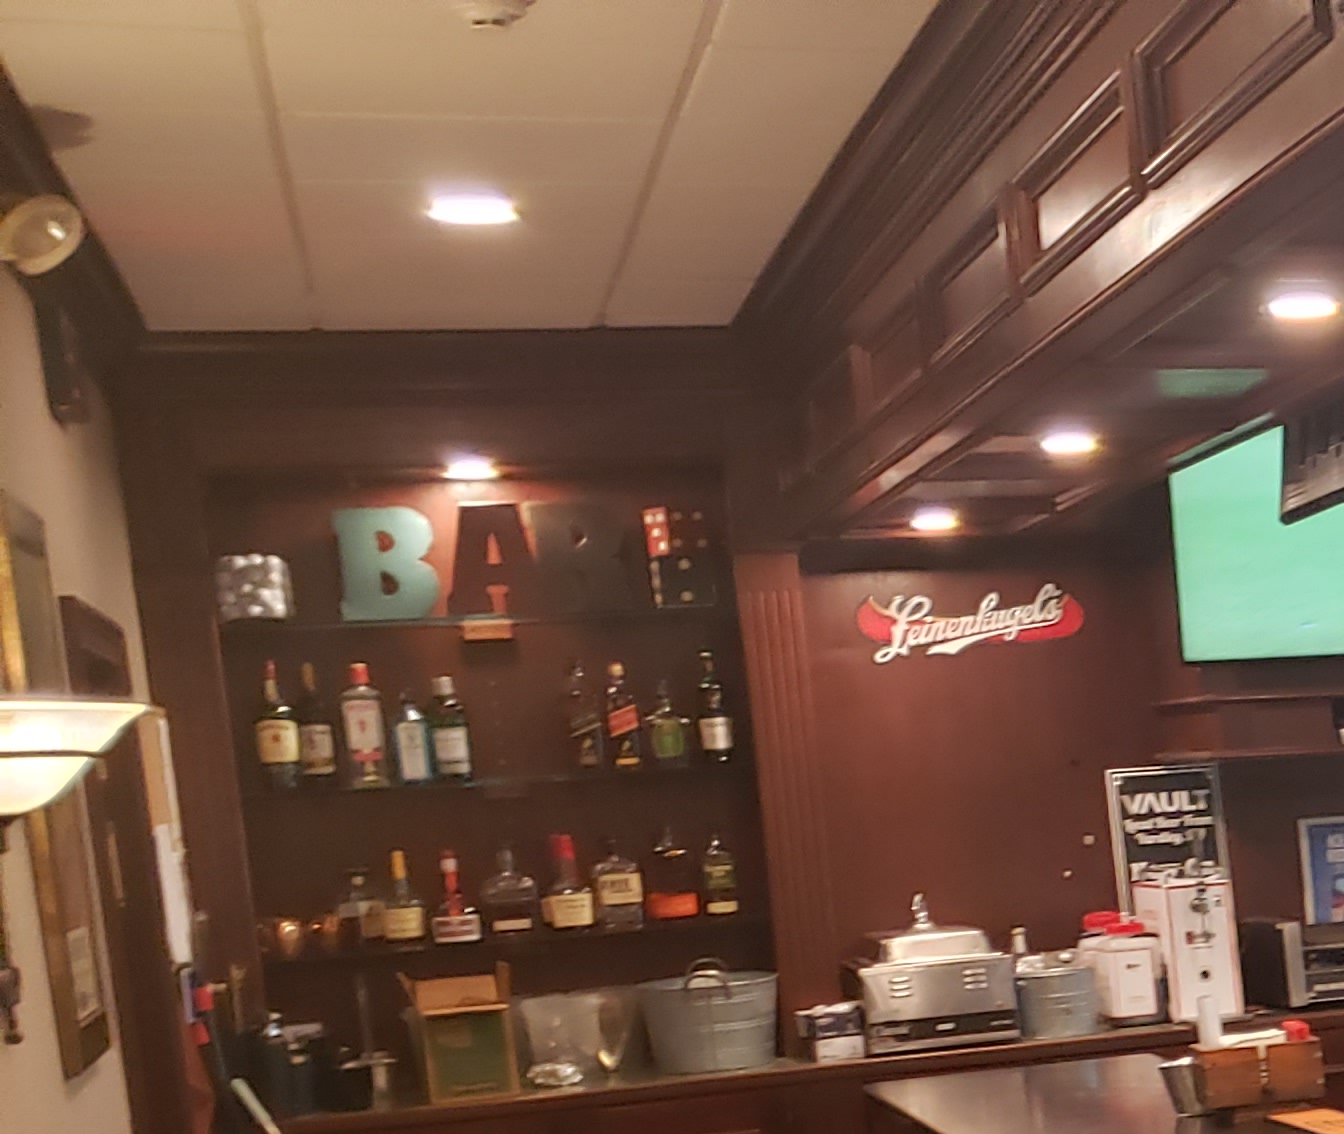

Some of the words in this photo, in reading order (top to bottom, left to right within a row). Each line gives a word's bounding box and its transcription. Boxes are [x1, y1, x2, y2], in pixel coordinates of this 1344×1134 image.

[331, 500, 612, 622] BAR
[872, 583, 1064, 664] Leinenkugel's
[1119, 788, 1210, 815] VAULT
